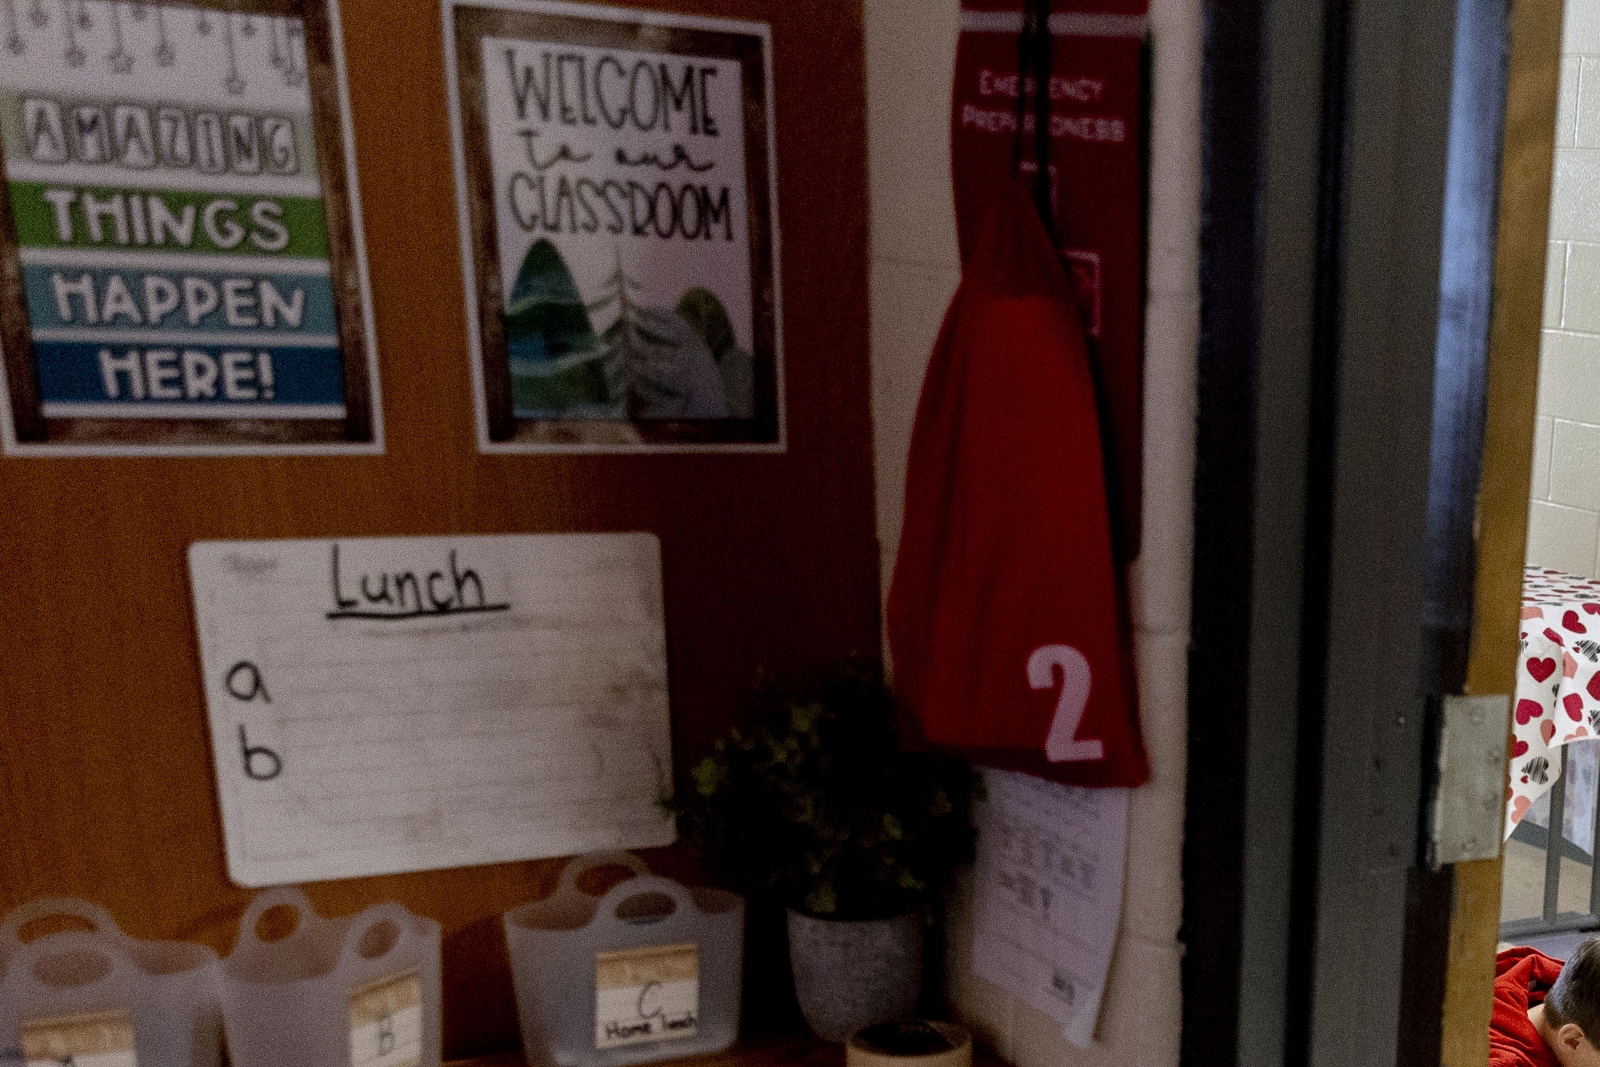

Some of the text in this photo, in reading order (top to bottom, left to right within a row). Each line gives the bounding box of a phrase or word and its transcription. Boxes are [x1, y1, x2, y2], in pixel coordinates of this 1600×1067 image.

[504, 48, 719, 136] WELCOME
[25, 100, 297, 174] AMAZING
[44, 190, 290, 253] THINGS
[508, 172, 734, 241] CLASSROOM
[51, 271, 305, 328] HAPPEN
[99, 348, 275, 400] HERE!
[331, 544, 486, 611] Lunch
[225, 660, 272, 703] a
[1026, 644, 1104, 763] 2
[238, 723, 283, 781] b
